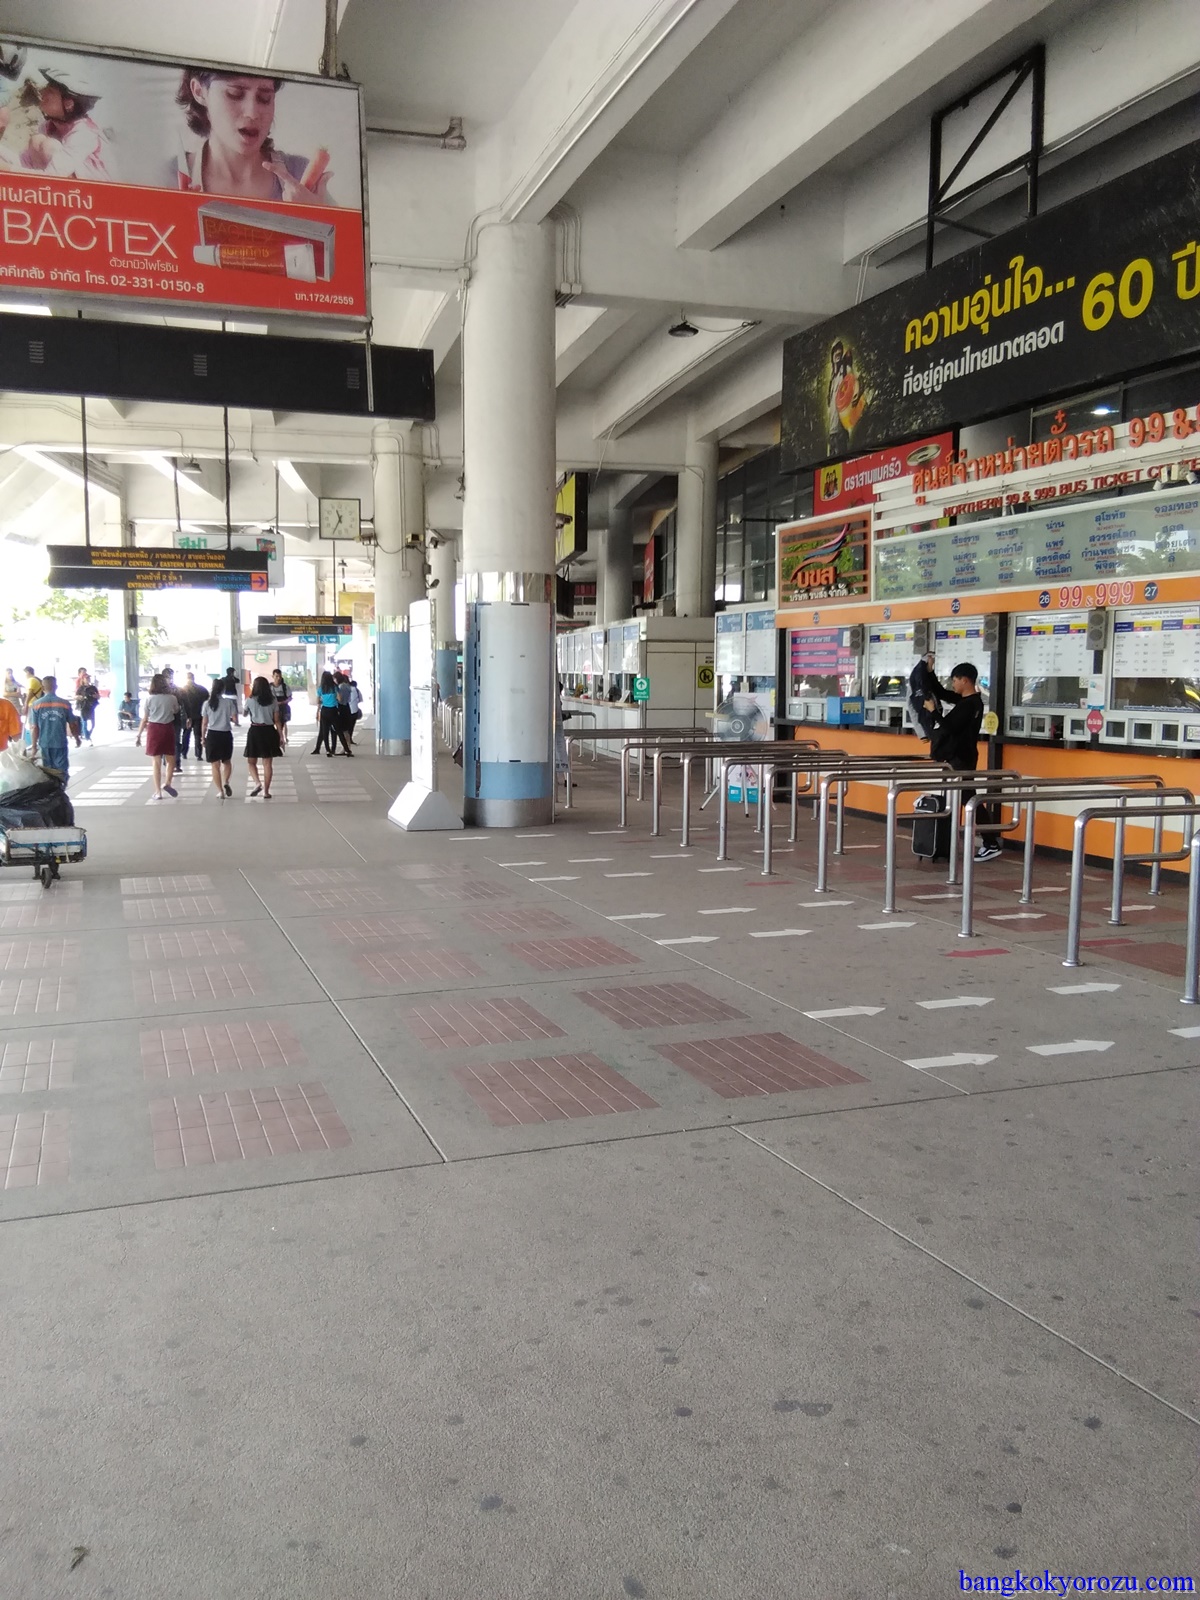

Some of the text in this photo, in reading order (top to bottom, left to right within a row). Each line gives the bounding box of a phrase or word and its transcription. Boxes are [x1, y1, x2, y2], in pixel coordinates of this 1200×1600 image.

[3, 208, 178, 259] BACTEX
[50, 268, 81, 283] จำกัด
[110, 275, 205, 293] 02-331-0150-8
[109, 256, 179, 273] ตัวยามิวไพโรซิน
[904, 255, 1076, 354] ความอุ่นใจ...
[1082, 258, 1154, 332] 60
[902, 320, 1065, 398] ที่อยู่คู่คนไทยมาตลอด
[844, 456, 901, 491] ตราสามแม่ครัว
[912, 409, 1115, 506] ศูนย์จำหน่ายตั๋วรถ
[1129, 411, 1166, 449] 99
[1173, 408, 1195, 440] &
[943, 468, 1144, 517] NORTHERN 99 & 999 BUS TICKET
[1154, 501, 1199, 513] จอมทอง
[951, 601, 961, 611] 25
[1039, 594, 1050, 605] 26
[1059, 585, 1084, 608] 99
[1095, 581, 1135, 607] 999
[1145, 586, 1158, 598] 27
